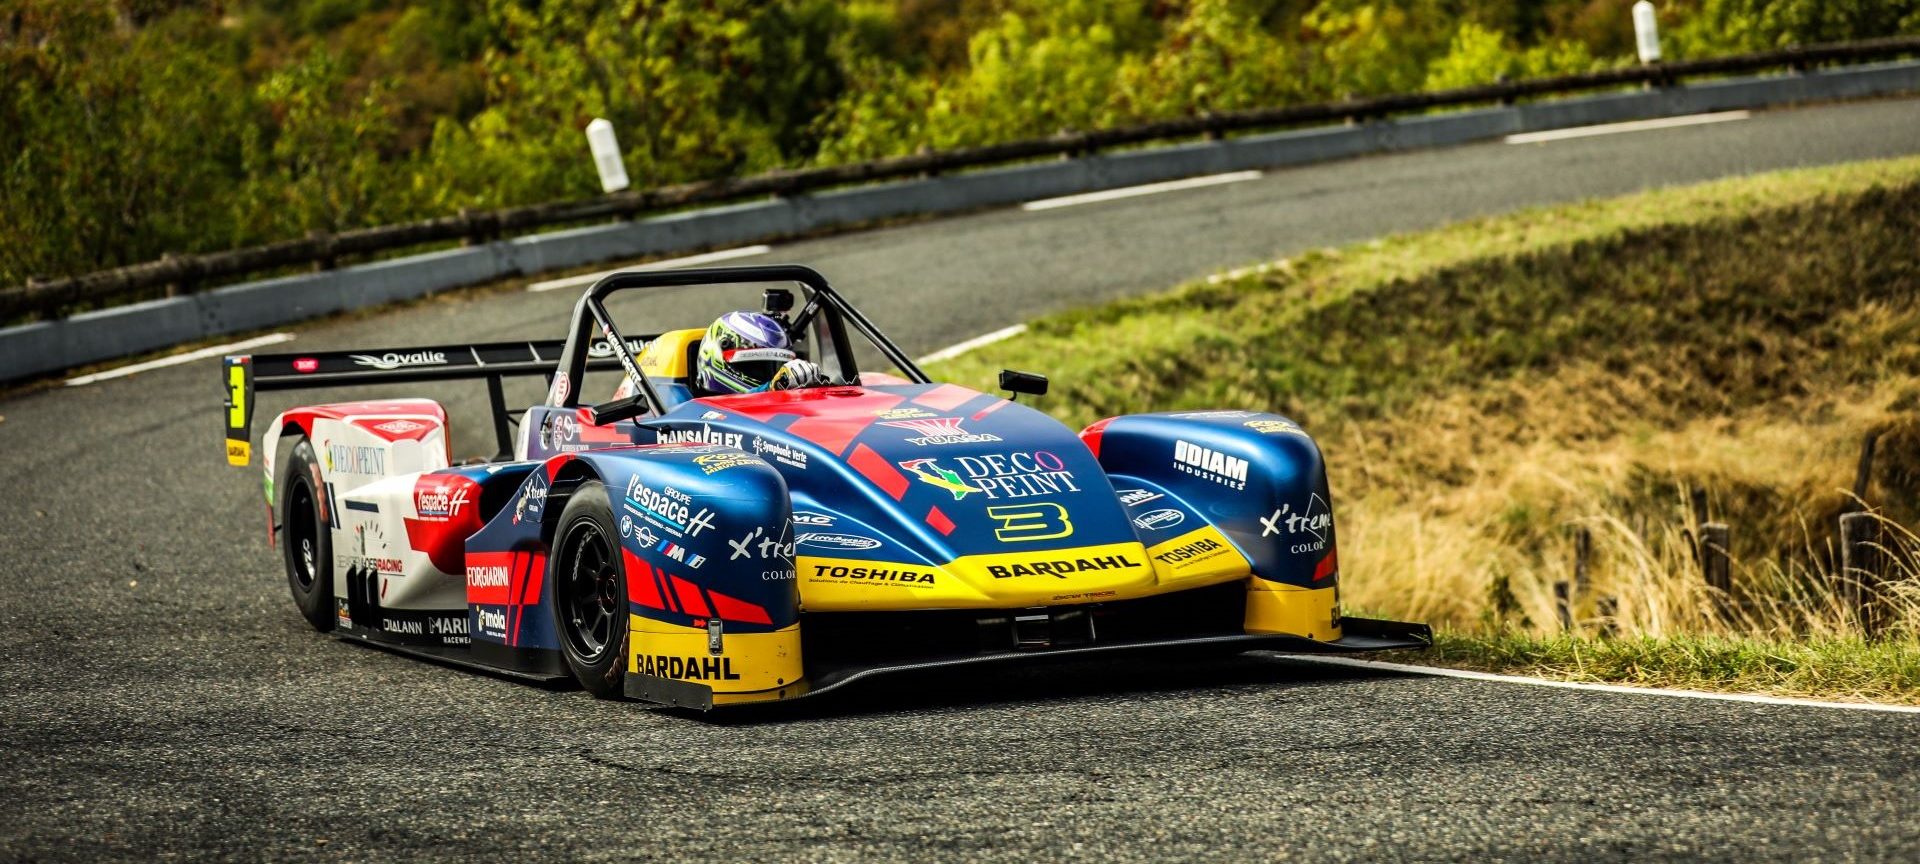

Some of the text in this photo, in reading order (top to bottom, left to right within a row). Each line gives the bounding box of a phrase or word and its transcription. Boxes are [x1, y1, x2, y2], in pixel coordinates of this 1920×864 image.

[904, 433, 1004, 446] YUASA
[953, 450, 1064, 478] DECO
[1173, 461, 1246, 491] INDUSTRIES
[664, 486, 692, 506] GROUPE
[972, 470, 1082, 499] PEINT
[792, 515, 832, 524] MC
[986, 502, 1074, 543] 3
[1154, 538, 1223, 565] TOSHIBA
[467, 566, 509, 588] FORGIARINI
[814, 565, 936, 584] TOSHIBA
[986, 554, 1142, 579] BARDAHL
[383, 618, 423, 634] DIALANN
[637, 653, 741, 681] BARDAHL
